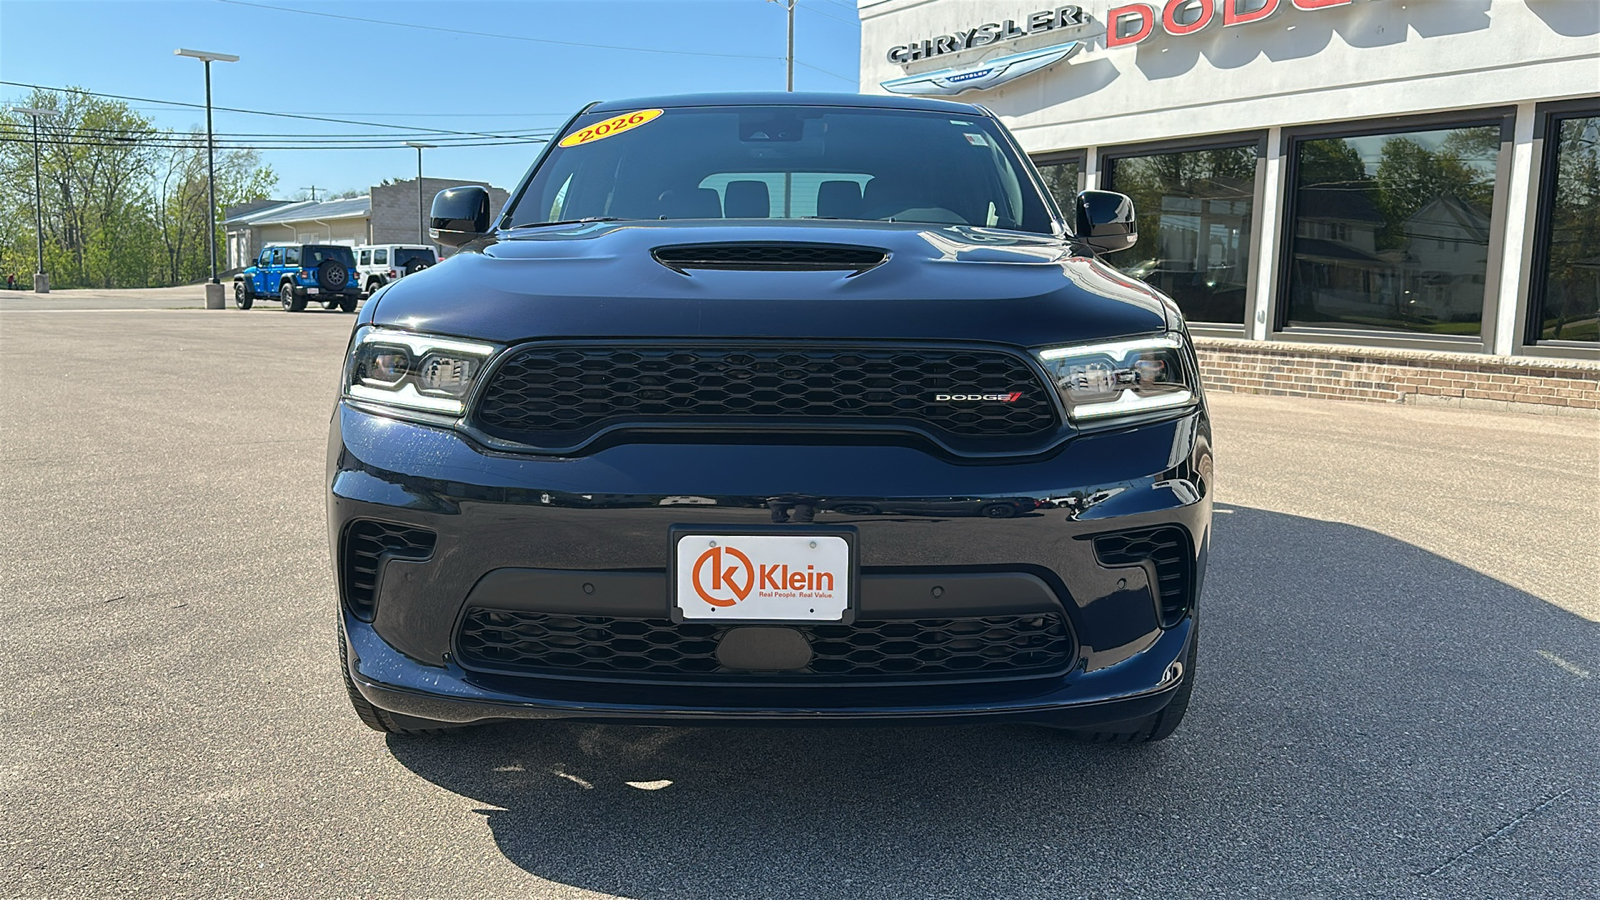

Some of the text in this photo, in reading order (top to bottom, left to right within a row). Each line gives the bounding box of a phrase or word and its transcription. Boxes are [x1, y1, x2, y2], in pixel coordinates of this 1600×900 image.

[886, 4, 1085, 65] CHRYSLER
[1106, 0, 1354, 49] DOD
[949, 70, 988, 82] CHRYSLER
[578, 111, 645, 143] 2026
[759, 564, 834, 591] Klein
